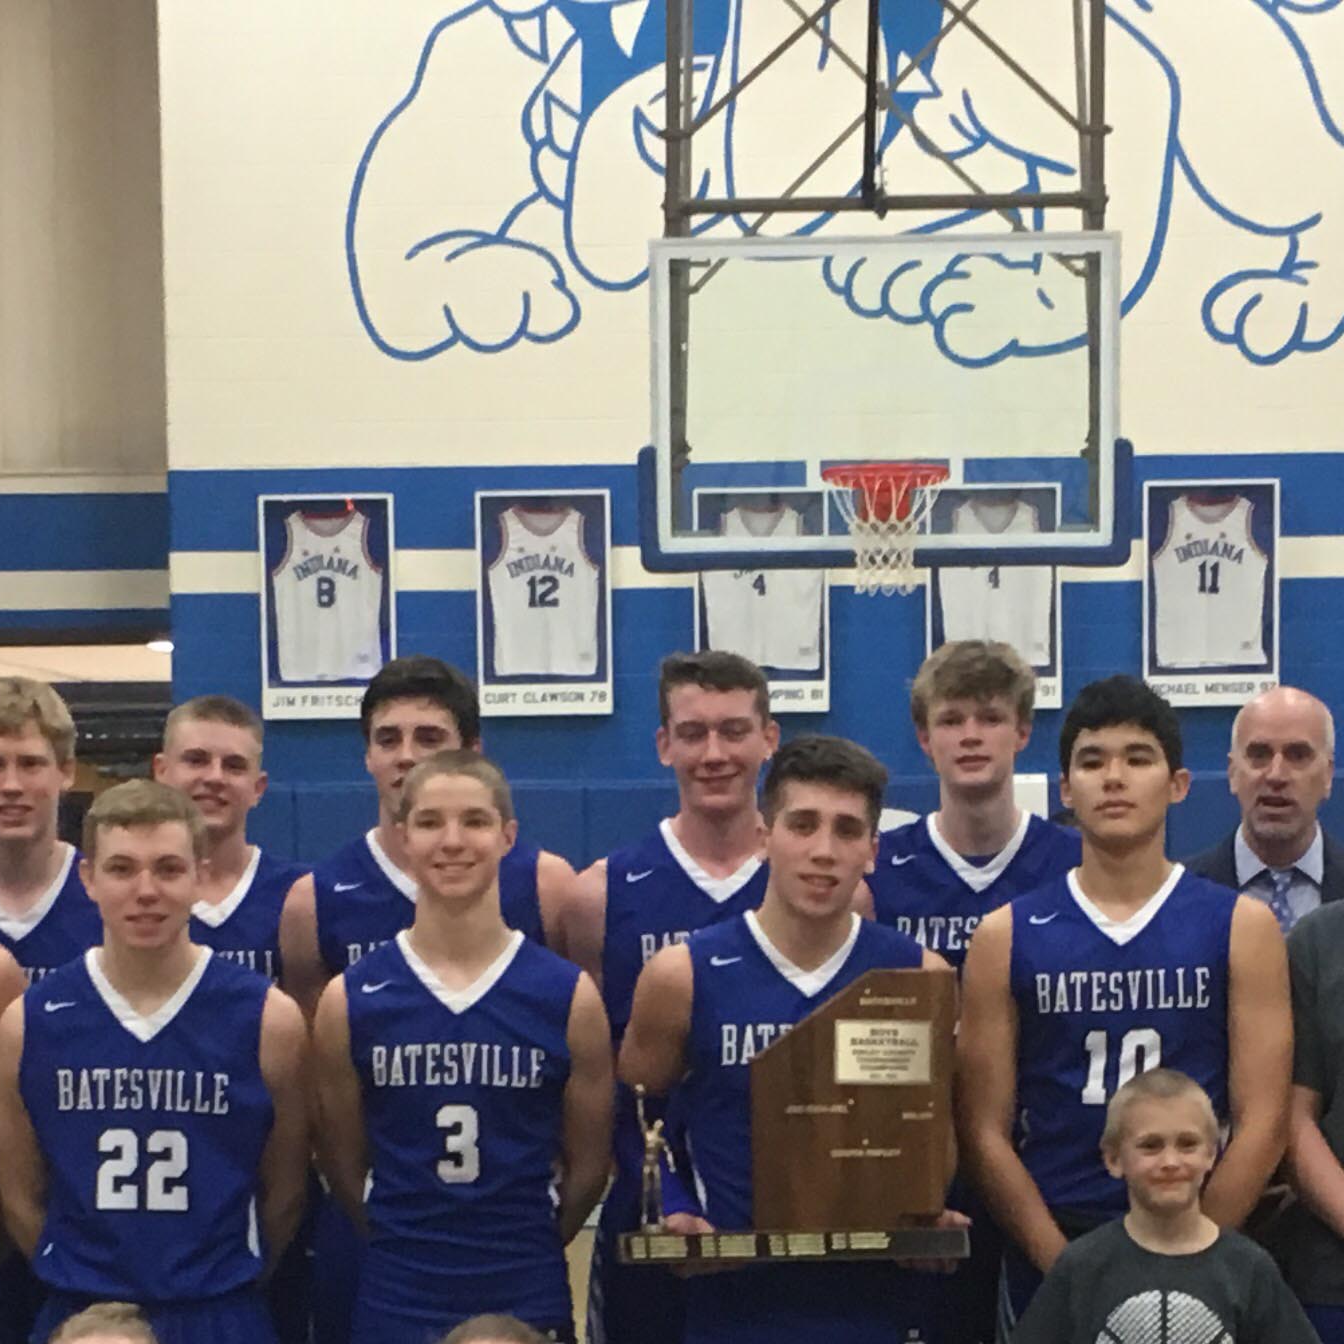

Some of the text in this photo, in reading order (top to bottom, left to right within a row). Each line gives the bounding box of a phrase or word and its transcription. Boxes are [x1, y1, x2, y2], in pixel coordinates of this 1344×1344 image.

[293, 554, 359, 581] INDIANA
[506, 554, 575, 578] INDIANA
[1174, 539, 1245, 565] INDIANA
[527, 575, 560, 608] 12
[752, 573, 766, 596] 4
[1197, 560, 1220, 594] 11
[273, 695, 295, 707] JIM
[484, 692, 517, 705] CURT
[523, 692, 585, 704] CLAWSON
[1035, 966, 1211, 1014] BATESVILLE
[372, 1043, 546, 1088] BATESVILLE
[57, 1067, 229, 1115] BATESVILLE
[435, 1104, 481, 1184] 3
[96, 1128, 189, 1211] 22
